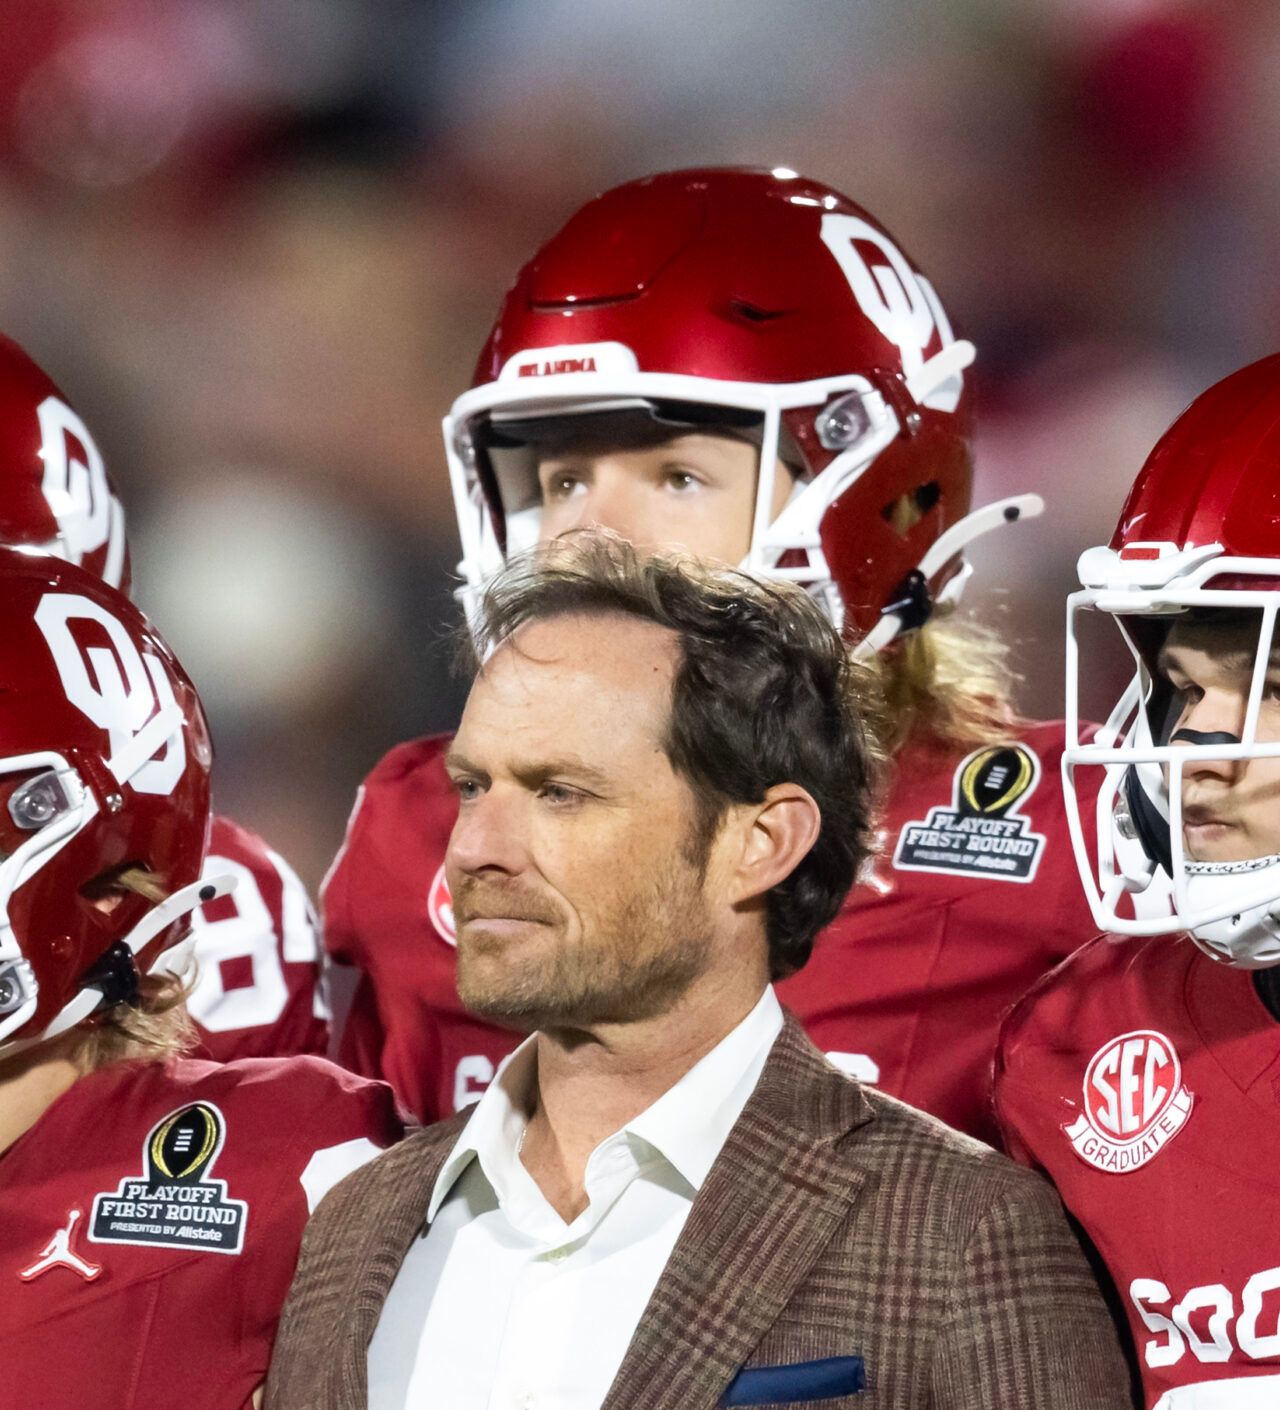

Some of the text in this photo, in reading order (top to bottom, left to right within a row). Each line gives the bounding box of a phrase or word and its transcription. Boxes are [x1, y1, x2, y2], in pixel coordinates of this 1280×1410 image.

[821, 215, 963, 412] OU
[35, 593, 187, 796] OU
[932, 814, 1020, 837] PLAYOFF
[907, 829, 1034, 856] FIRST ROUND
[1092, 1039, 1169, 1134] SEC
[1082, 1116, 1176, 1170] GRADUATE
[126, 1185, 217, 1203] PLAYOFF
[101, 1201, 237, 1225] FIRST ROUND
[110, 1222, 222, 1241] PRESENTED BY Allstate
